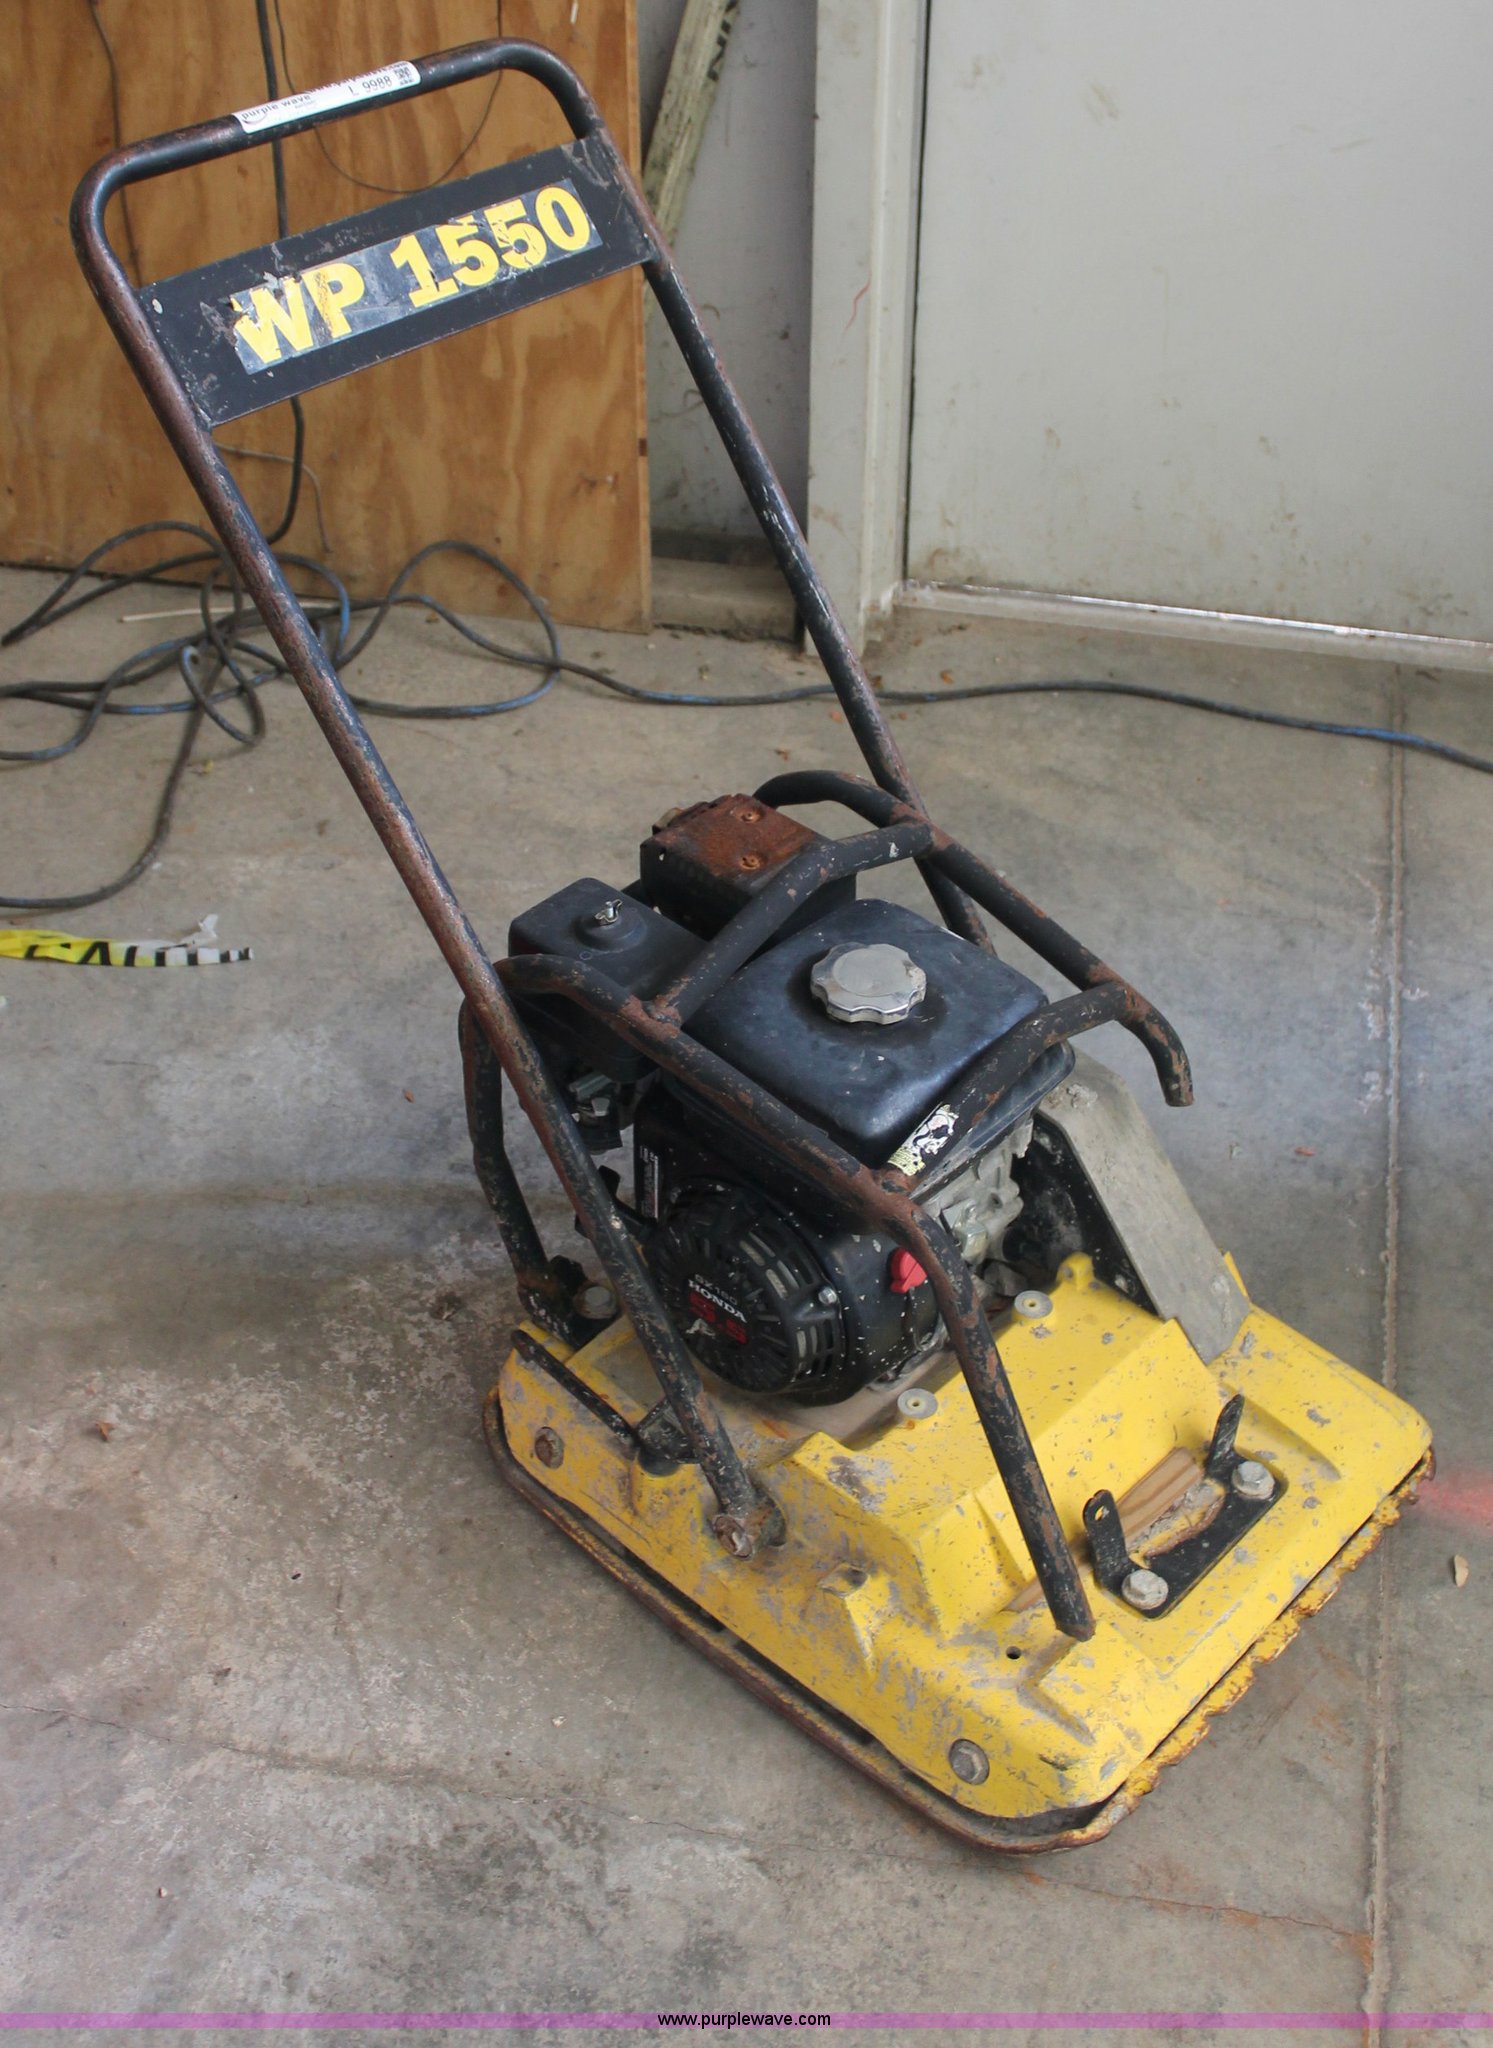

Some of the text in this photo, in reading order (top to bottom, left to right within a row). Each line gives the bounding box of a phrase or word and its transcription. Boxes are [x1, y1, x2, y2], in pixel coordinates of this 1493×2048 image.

[362, 75, 393, 93] 9988
[241, 103, 279, 120] purple
[281, 94, 311, 107] wave
[230, 186, 591, 364] WP 1550
[688, 1278, 748, 1324] HONDA
